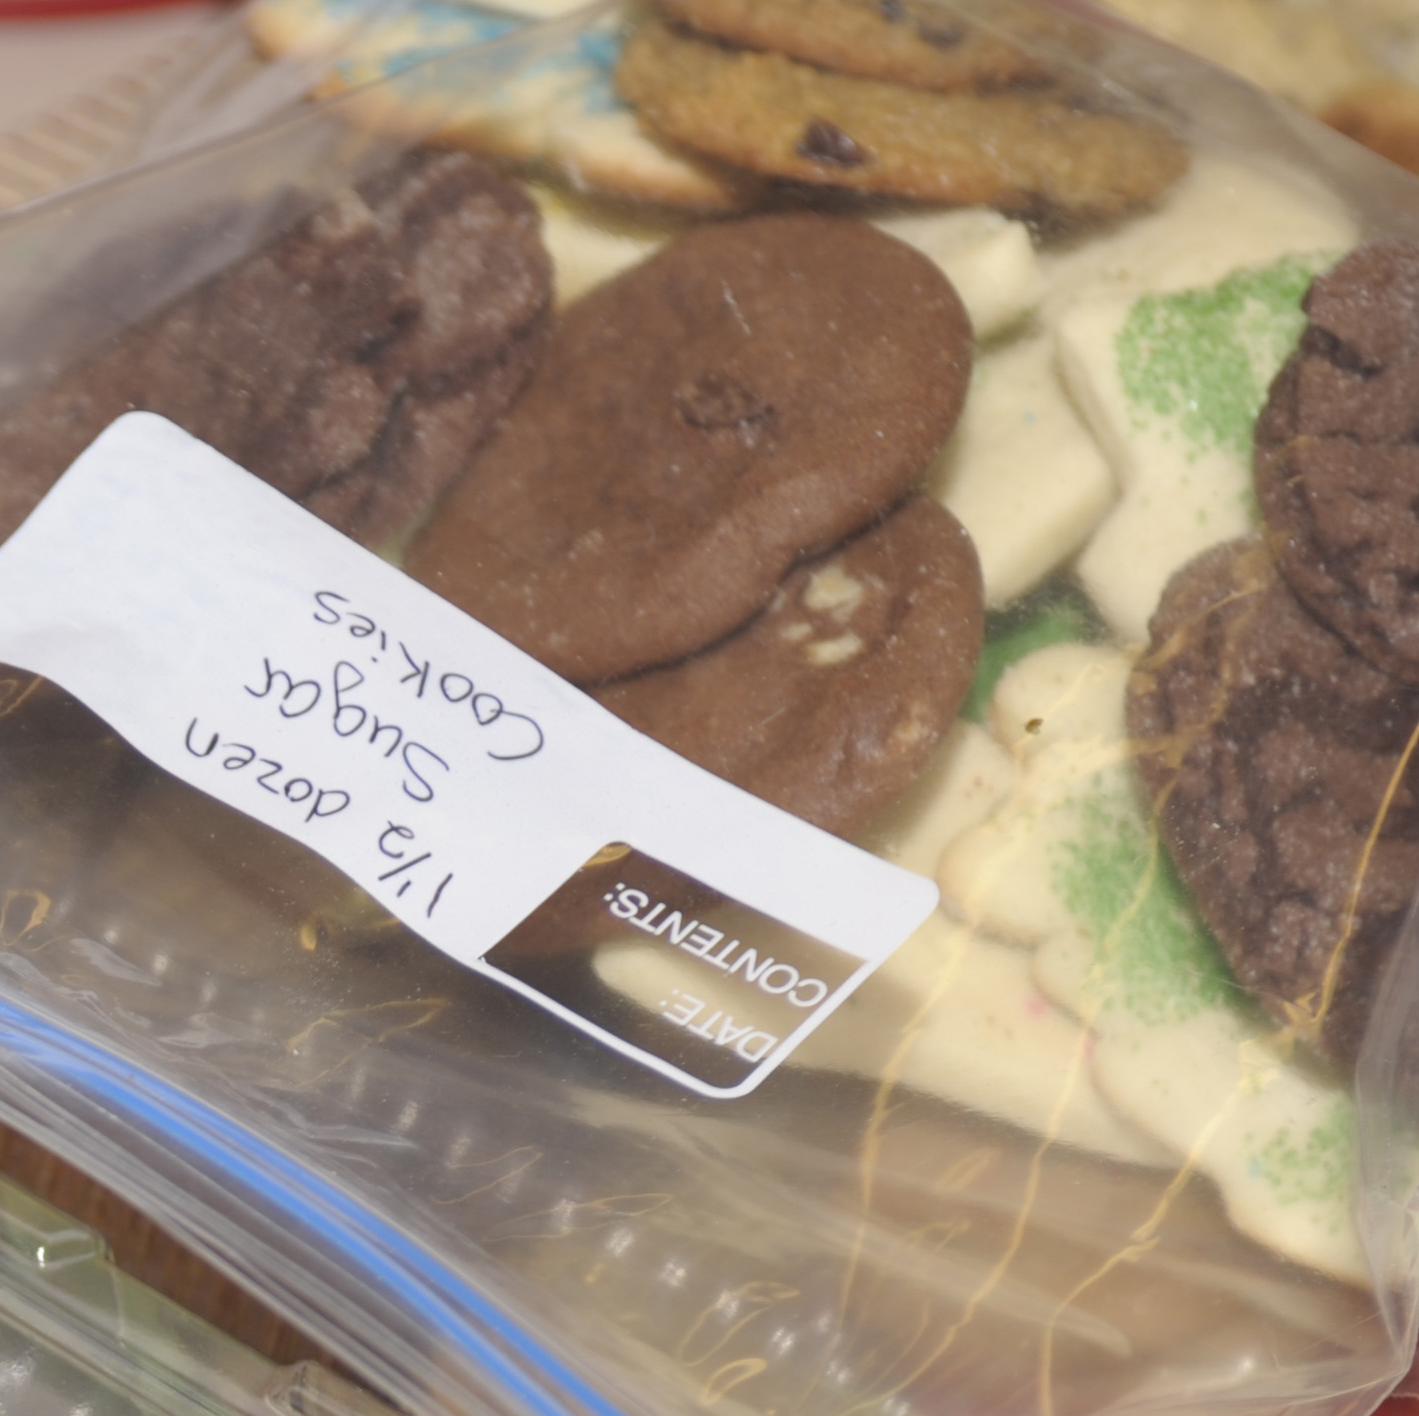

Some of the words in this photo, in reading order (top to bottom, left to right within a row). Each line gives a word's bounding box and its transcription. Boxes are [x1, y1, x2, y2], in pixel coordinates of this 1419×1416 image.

[244, 657, 450, 803] Sugar
[313, 590, 545, 761] Cookies
[184, 717, 351, 823] dozen
[603, 882, 829, 1009] CONTENTS:
[659, 988, 779, 1064] DATE:
